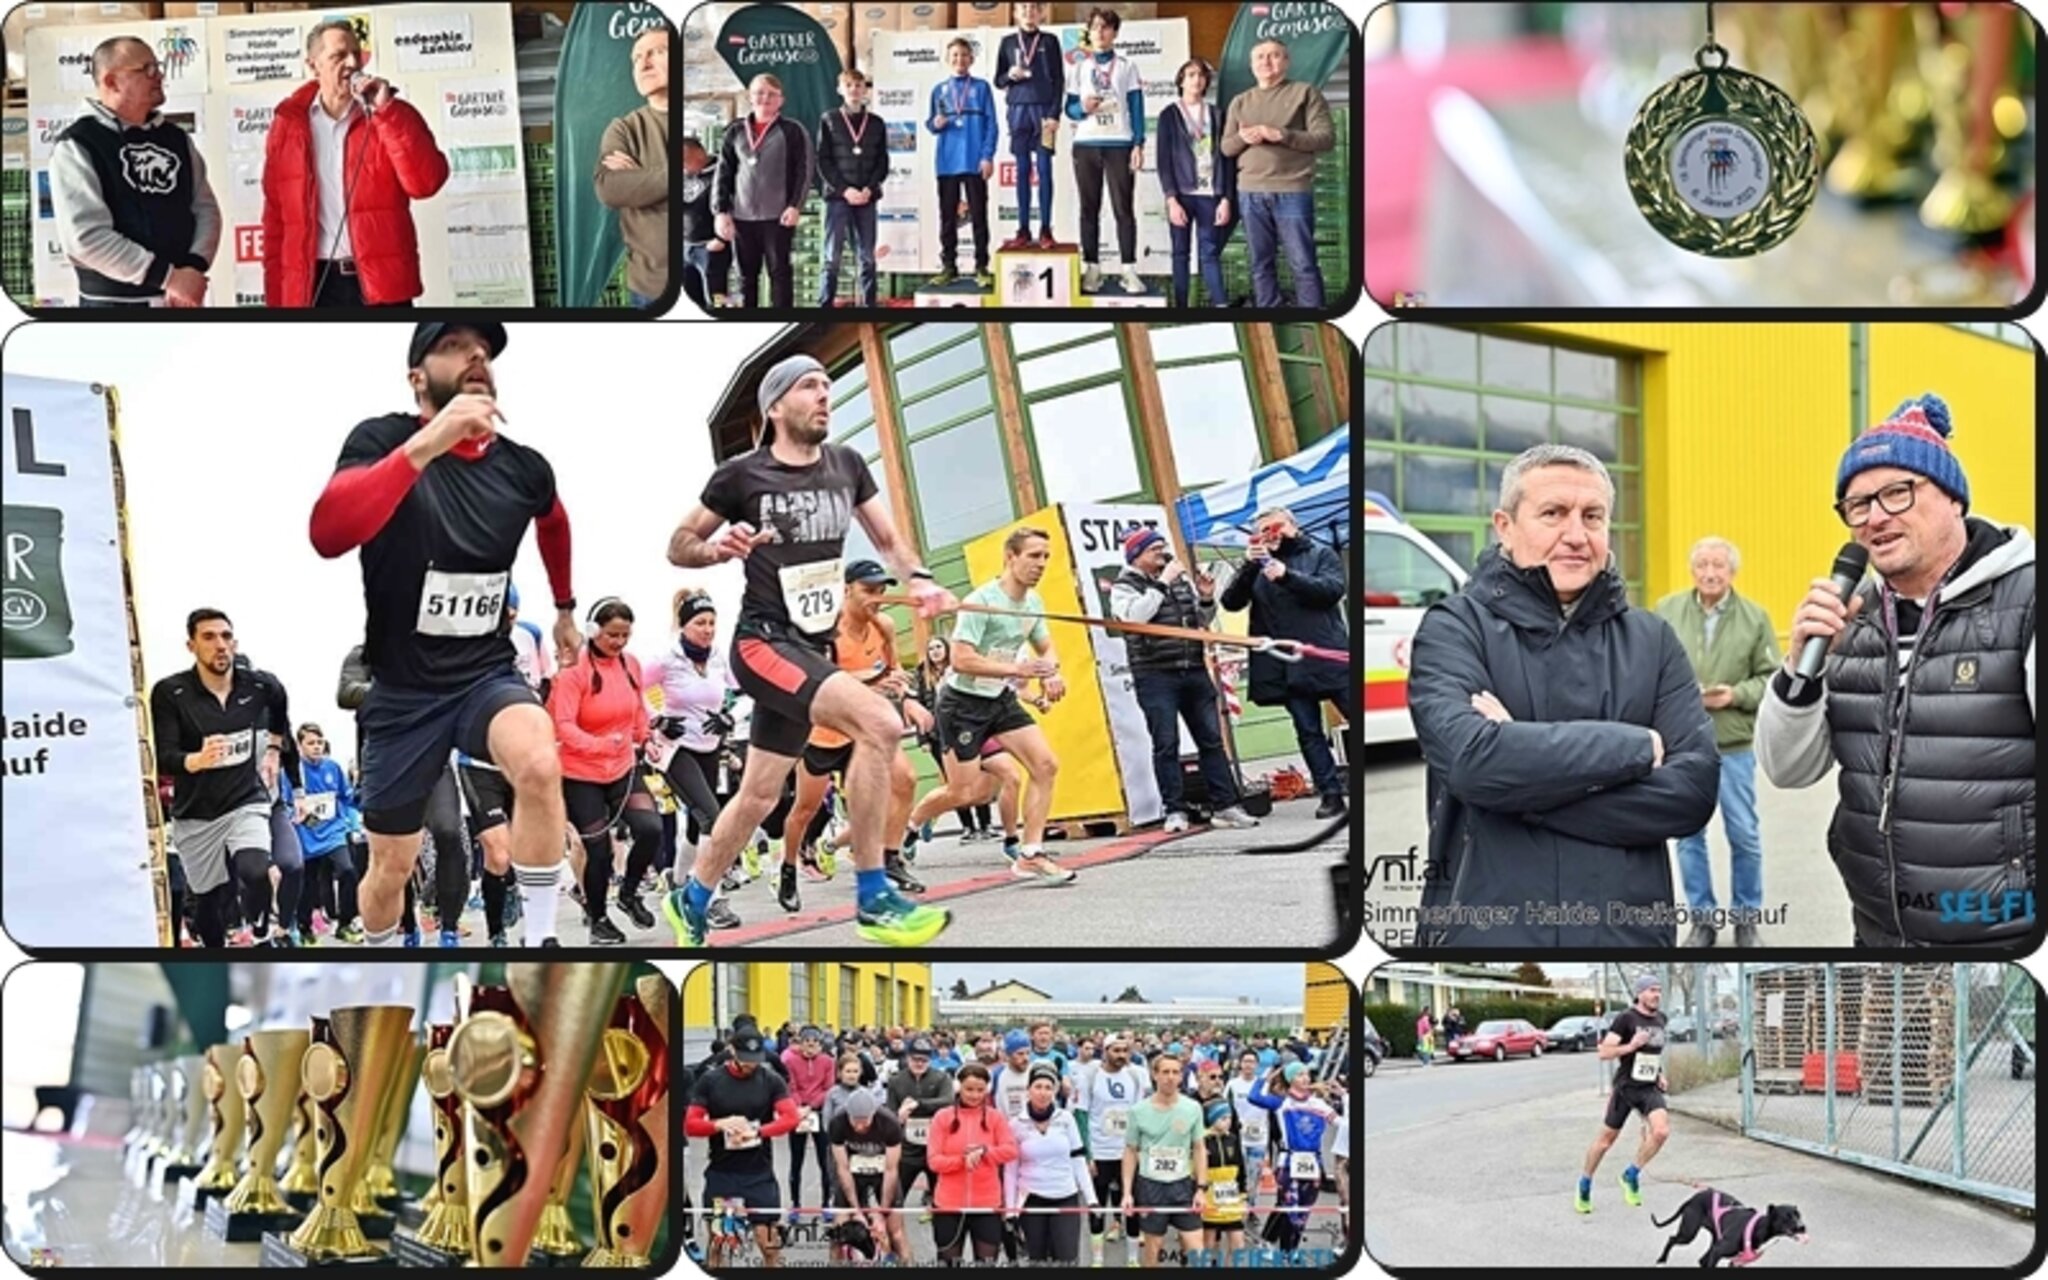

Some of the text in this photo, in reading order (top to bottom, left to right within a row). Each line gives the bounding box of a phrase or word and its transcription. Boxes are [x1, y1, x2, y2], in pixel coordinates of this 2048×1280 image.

[1039, 267, 1053, 299] 1
[427, 593, 501, 618] 51166
[799, 588, 833, 617] 279
